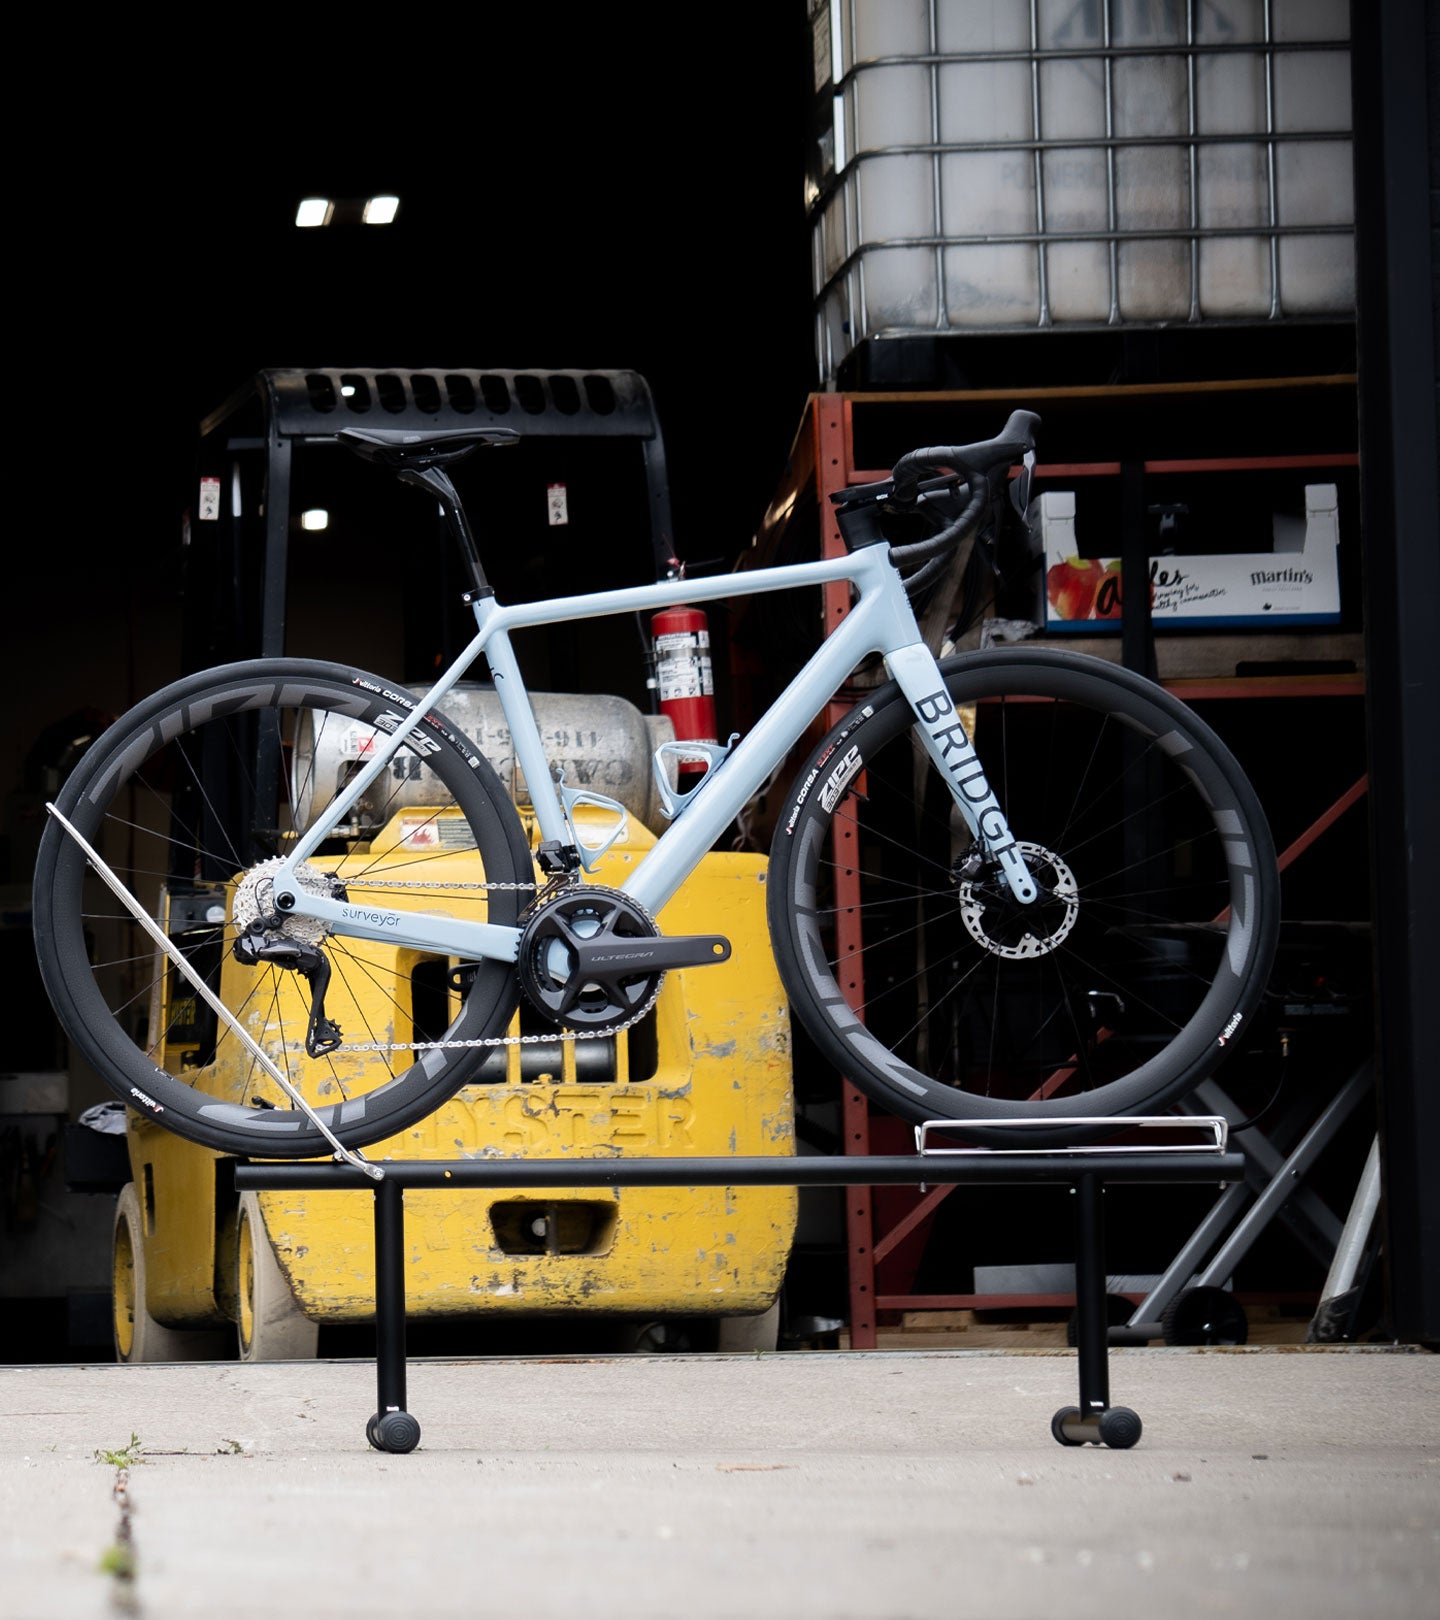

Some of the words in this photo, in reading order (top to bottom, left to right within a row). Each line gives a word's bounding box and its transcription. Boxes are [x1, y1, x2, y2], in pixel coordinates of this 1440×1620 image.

[796, 768, 820, 805] CORSA
[817, 744, 859, 808] ZIPP
[591, 951, 655, 962] ULTEGRA
